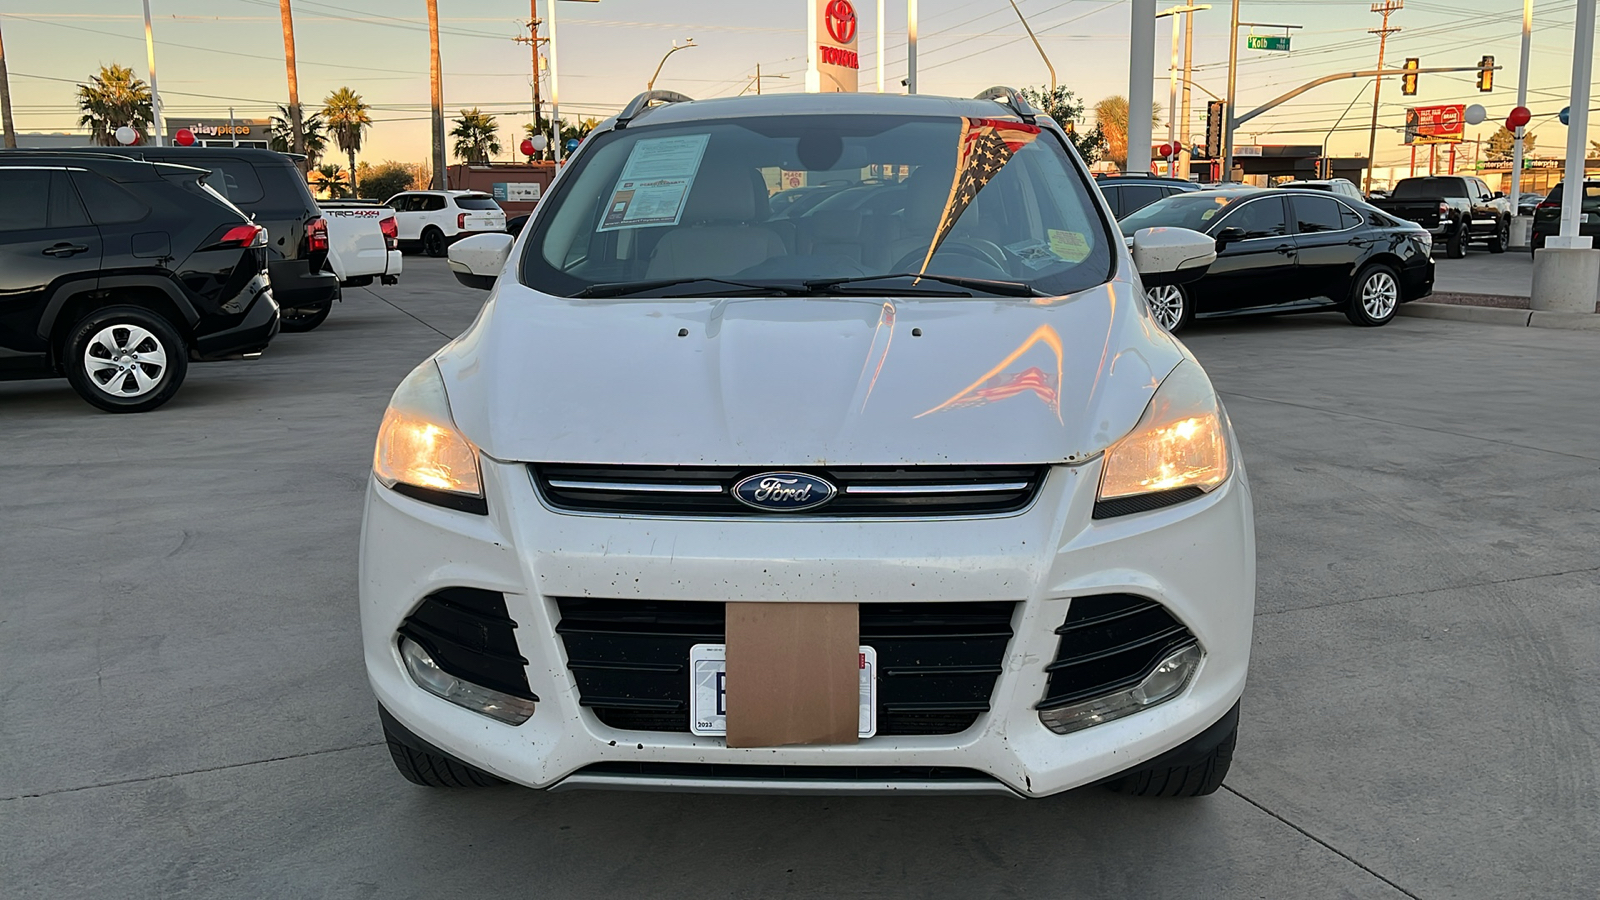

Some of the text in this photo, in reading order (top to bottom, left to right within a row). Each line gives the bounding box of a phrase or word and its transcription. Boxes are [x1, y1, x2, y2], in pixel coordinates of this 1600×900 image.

[1252, 37, 1268, 49] Kolb
[819, 46, 859, 69] TOYOTA
[754, 477, 811, 502] Ford
